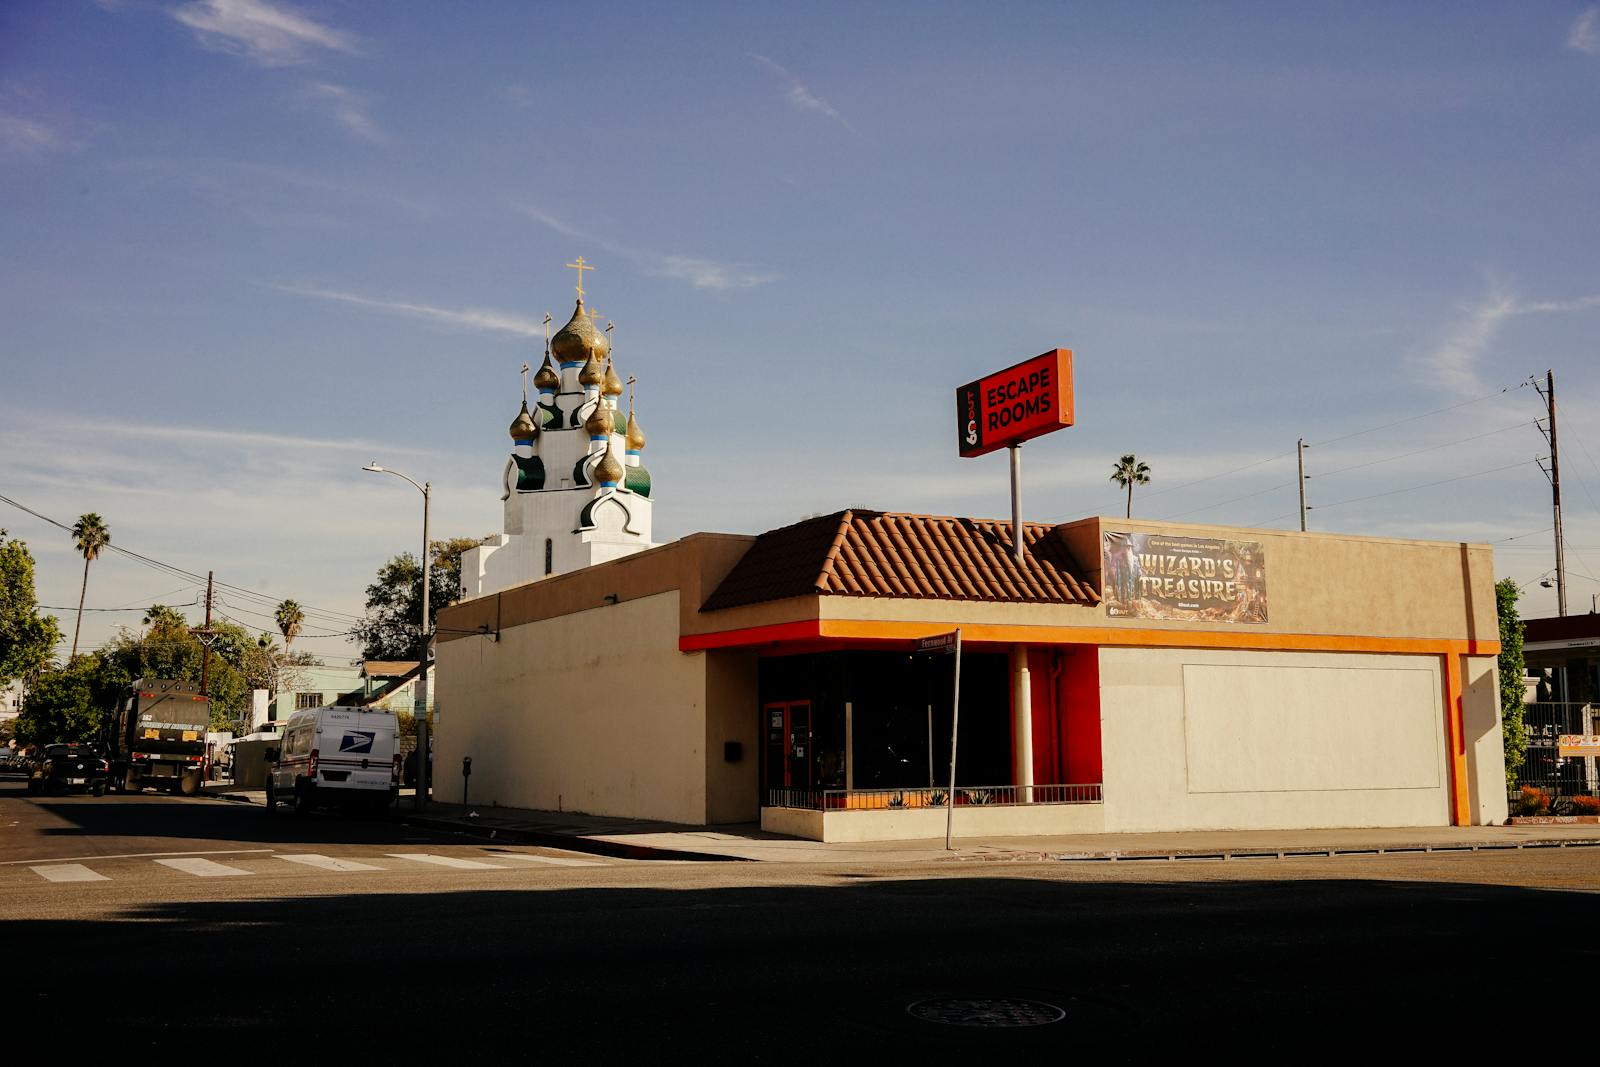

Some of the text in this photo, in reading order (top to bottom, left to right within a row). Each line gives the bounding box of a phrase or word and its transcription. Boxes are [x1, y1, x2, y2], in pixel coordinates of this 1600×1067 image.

[987, 367, 1050, 409] ESCAPE
[987, 391, 1051, 432] ROOMS
[1138, 553, 1235, 579] WIZARD'S
[1138, 576, 1237, 601] TREASURE
